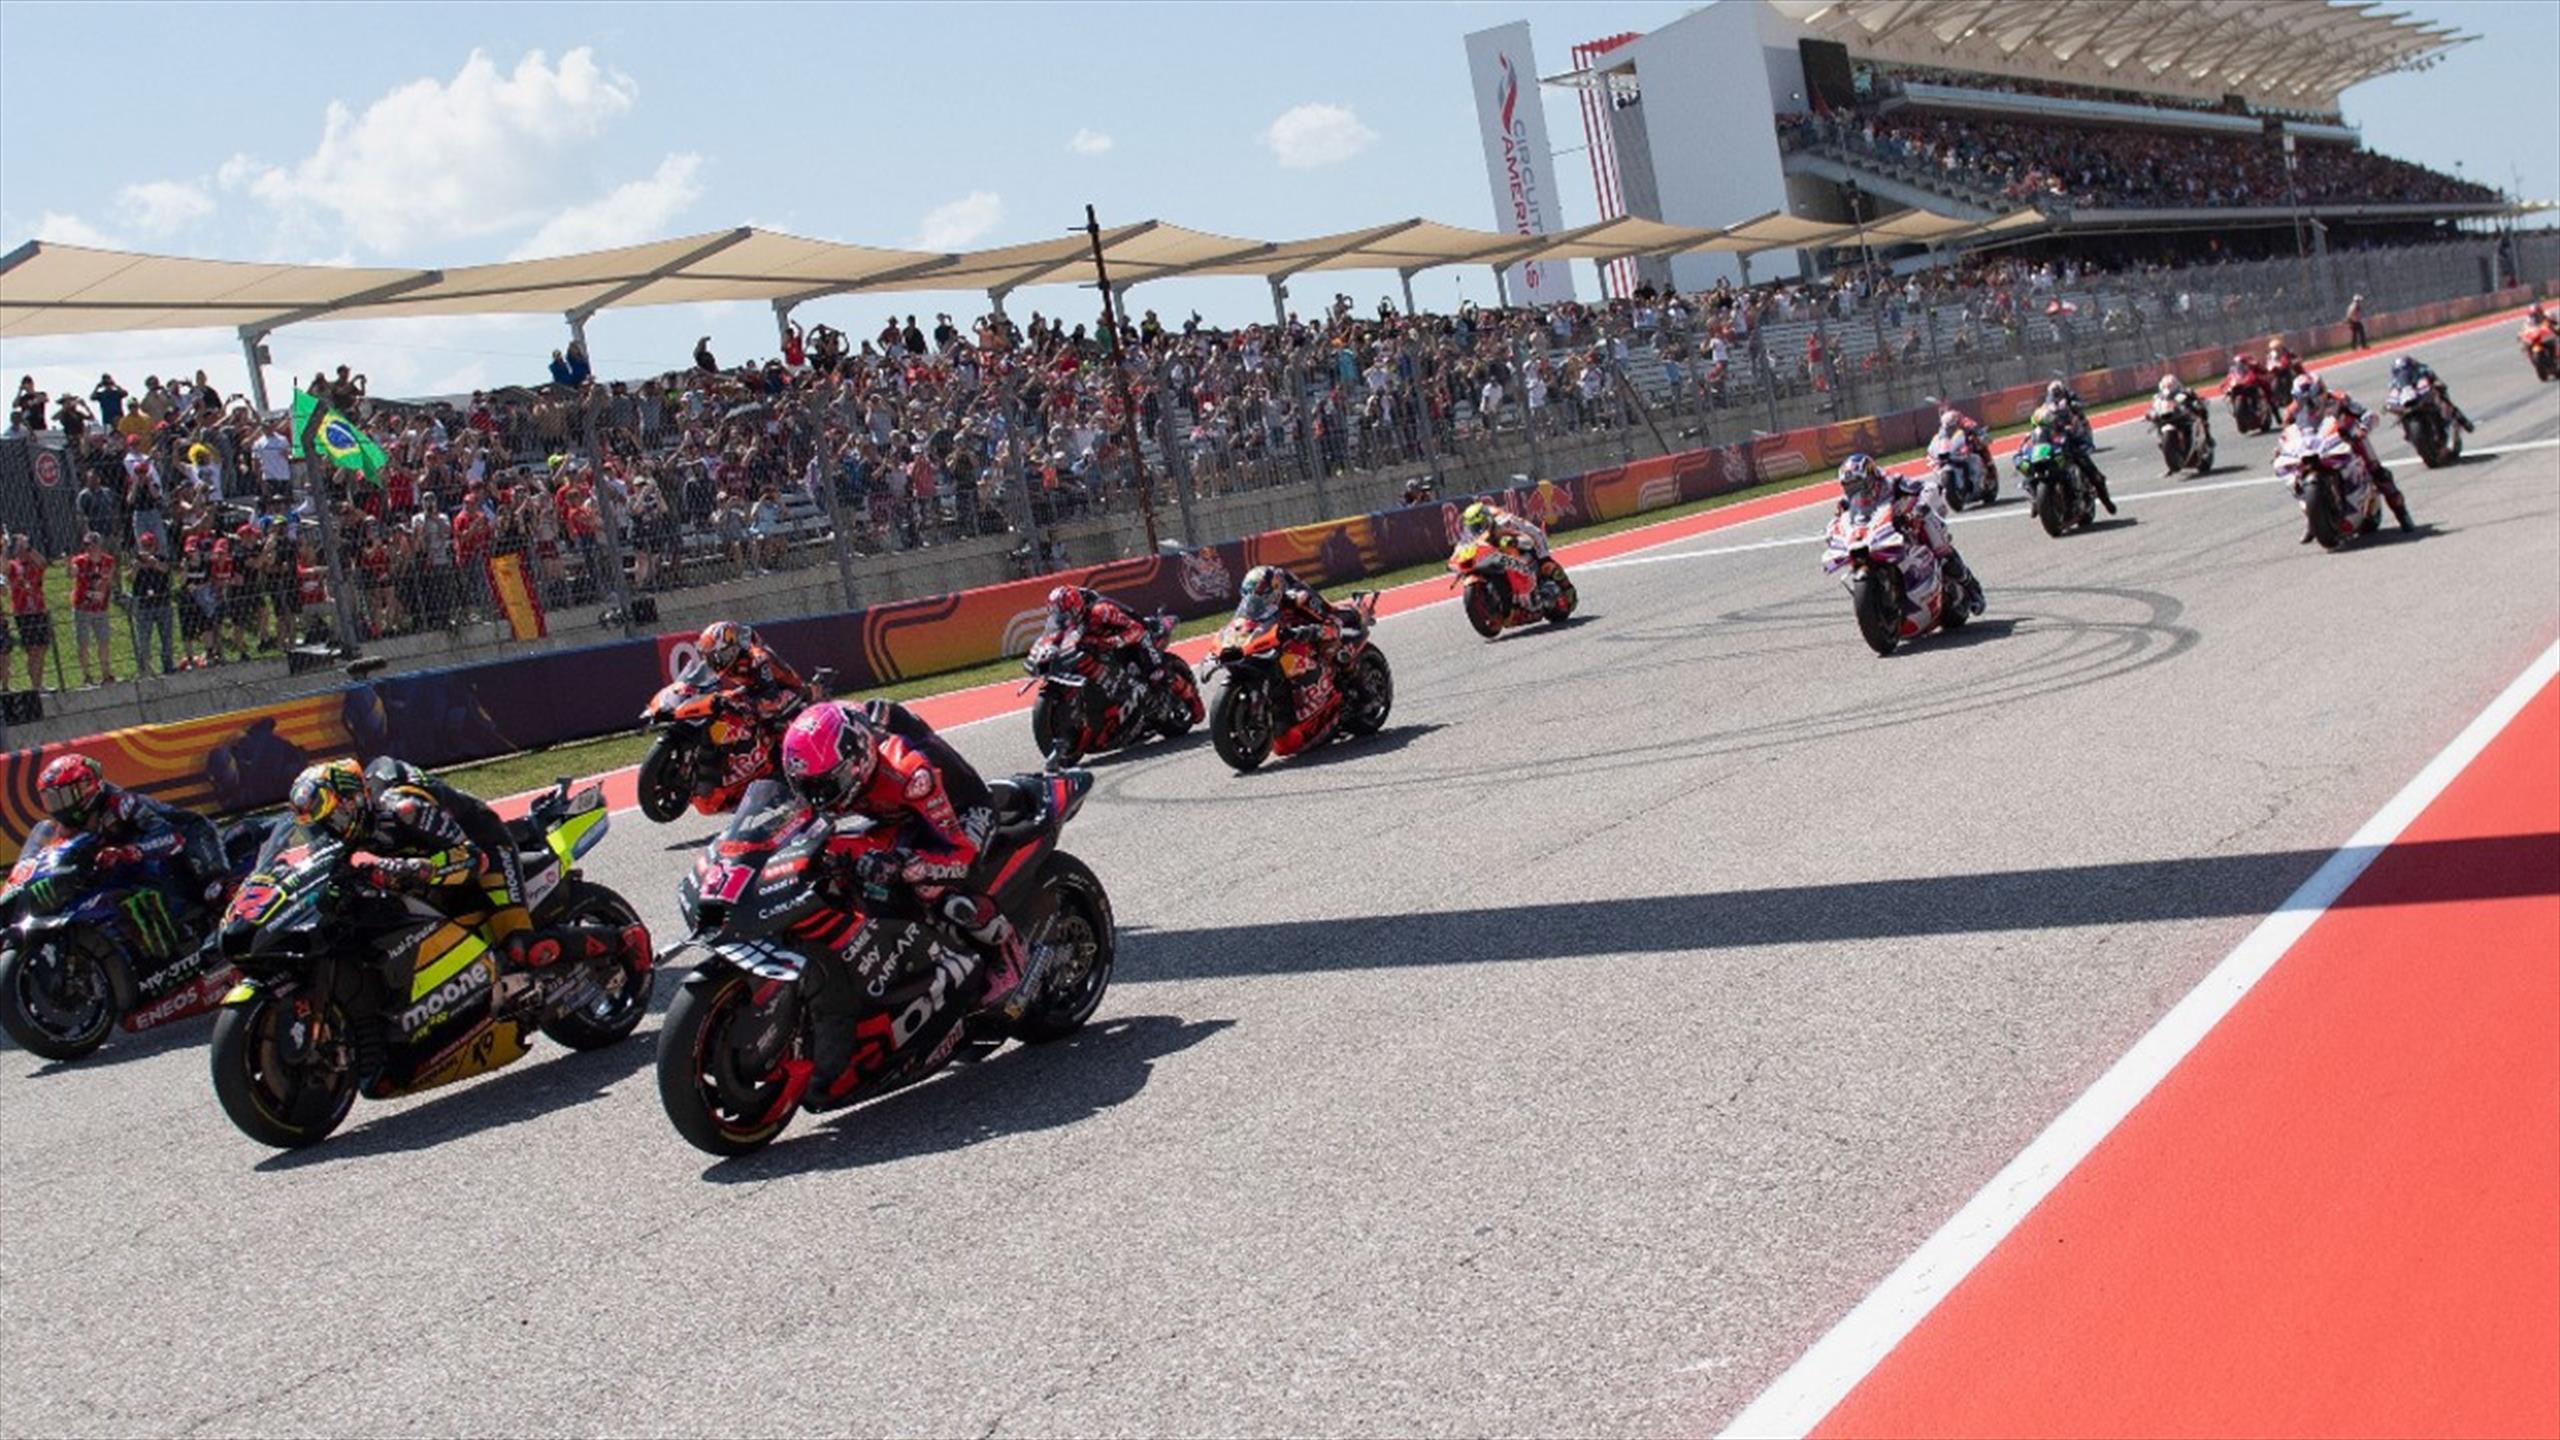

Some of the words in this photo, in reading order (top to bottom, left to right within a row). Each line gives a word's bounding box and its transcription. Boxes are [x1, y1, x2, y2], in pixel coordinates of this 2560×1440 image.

[1502, 136, 1540, 290] AMERIS
[1514, 119, 1543, 233] CIRCUIT
[136, 987, 197, 1030] ENEOS
